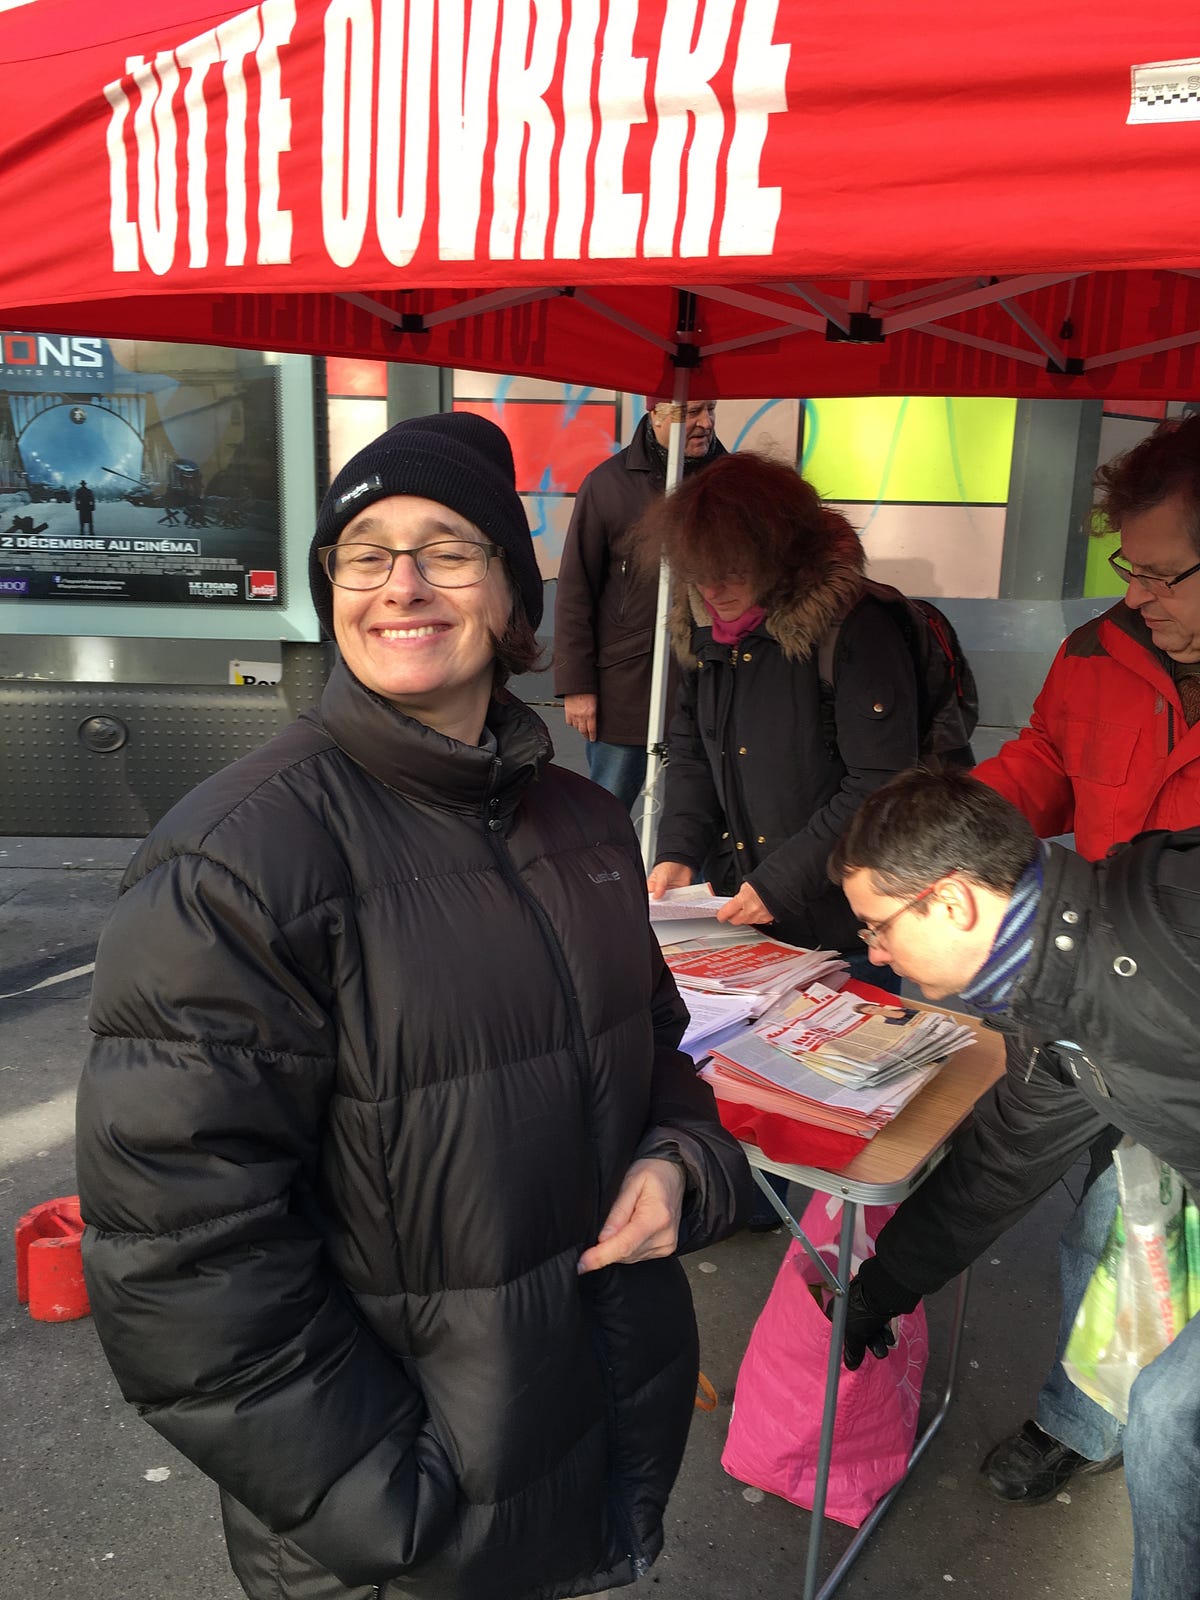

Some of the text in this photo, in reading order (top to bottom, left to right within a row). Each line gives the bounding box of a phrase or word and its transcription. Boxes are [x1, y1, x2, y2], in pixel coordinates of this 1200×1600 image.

[103, 0, 296, 275] LUTTE
[0, 335, 103, 367] ONS
[1, 536, 195, 552] 2 DÉCEMBRE AU CINÉMA
